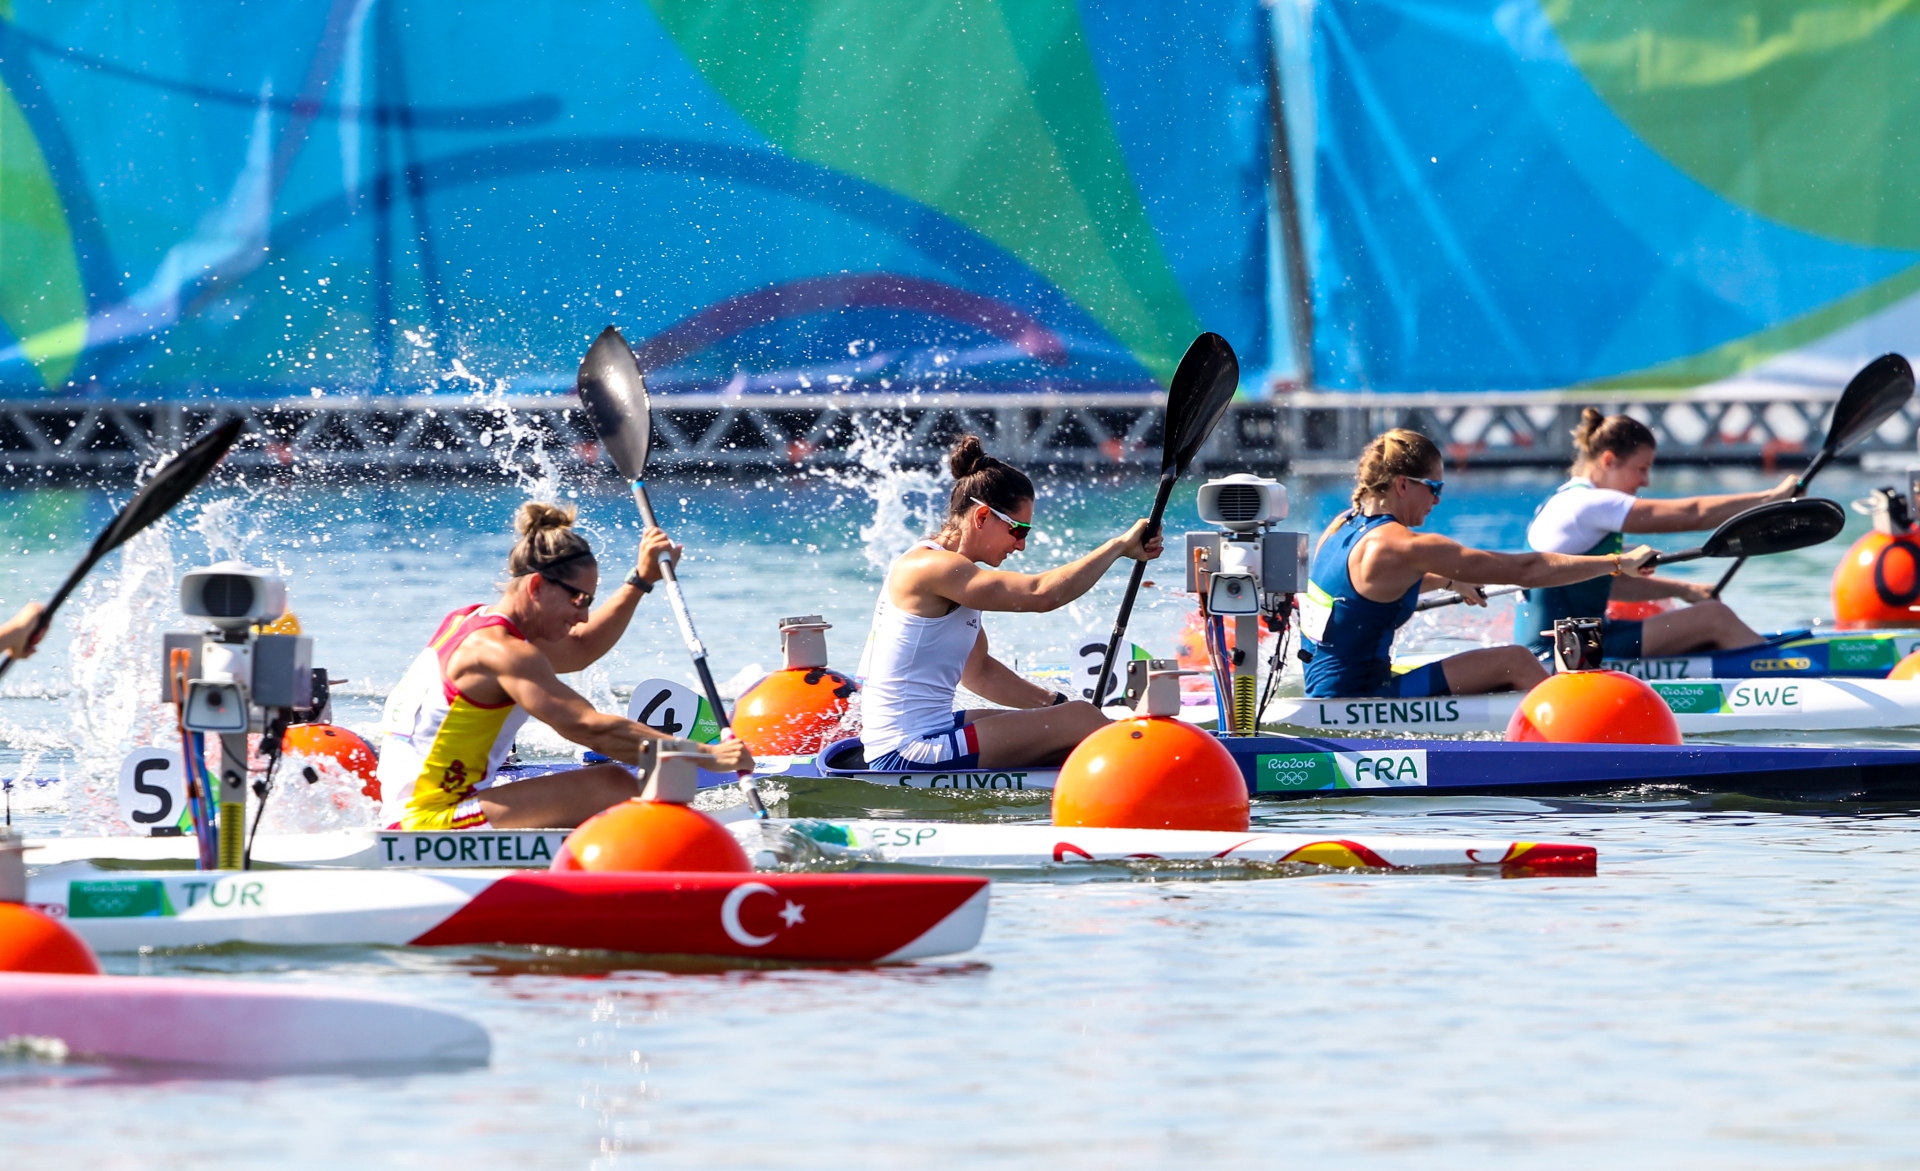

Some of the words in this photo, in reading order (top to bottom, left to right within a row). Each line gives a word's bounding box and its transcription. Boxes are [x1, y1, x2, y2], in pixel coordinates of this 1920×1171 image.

[1660, 686, 1704, 696] Rio2016
[1734, 686, 1799, 707] SWE
[637, 689, 682, 737] 4
[1319, 704, 1339, 725] L.
[1345, 700, 1460, 724] STENSILS
[1267, 757, 1316, 769] Rio2016
[1355, 756, 1418, 782] FRA
[930, 772, 1028, 791] GUYOT
[872, 827, 937, 847] ESP
[381, 836, 406, 862] T.
[414, 836, 553, 862] PORTELA
[180, 882, 265, 908] TUR
